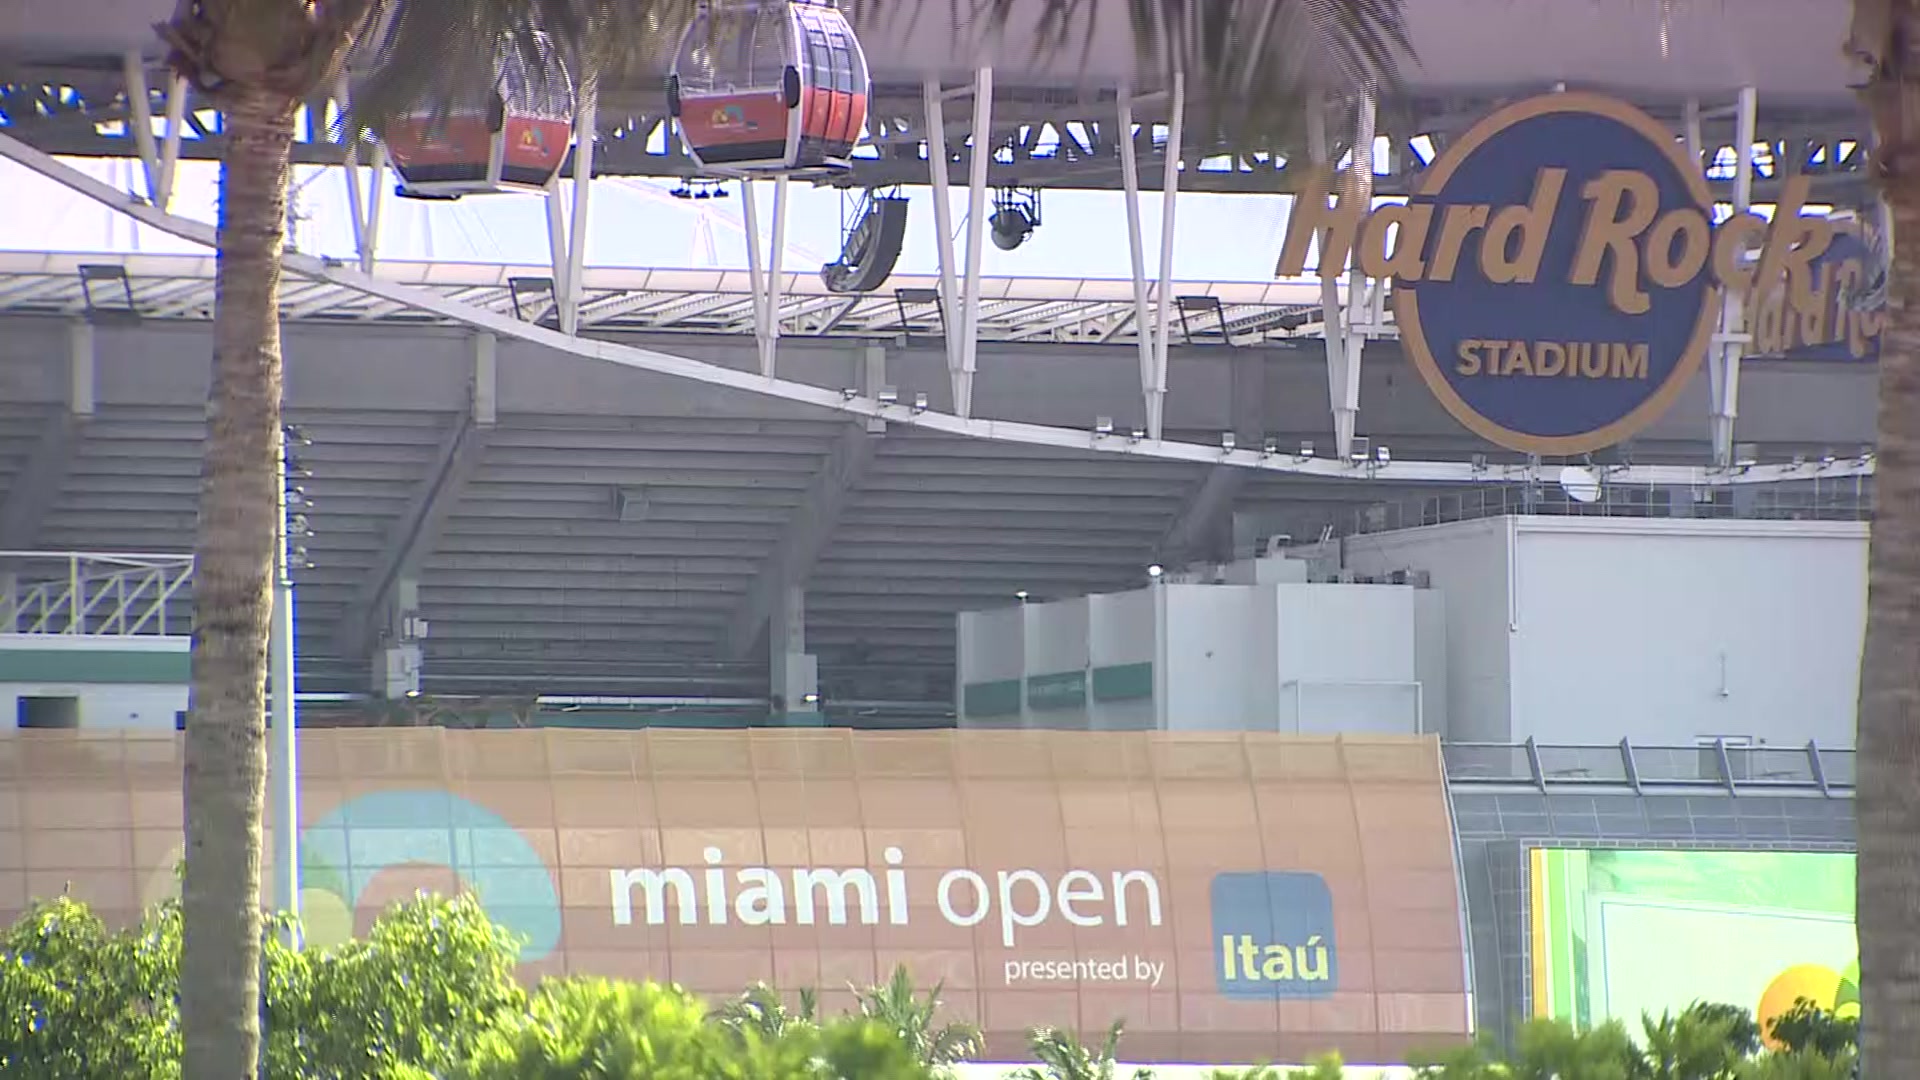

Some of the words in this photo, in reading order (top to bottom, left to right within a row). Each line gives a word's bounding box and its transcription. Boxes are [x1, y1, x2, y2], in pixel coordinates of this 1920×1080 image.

[1276, 161, 1568, 285] Hard
[1569, 167, 1832, 314] Rock
[1457, 339, 1650, 380] STADIUM
[609, 846, 909, 925] miami
[936, 868, 1162, 946] open
[1004, 955, 1128, 984] presented
[1134, 955, 1164, 987] by
[1222, 934, 1329, 981] Itaú
